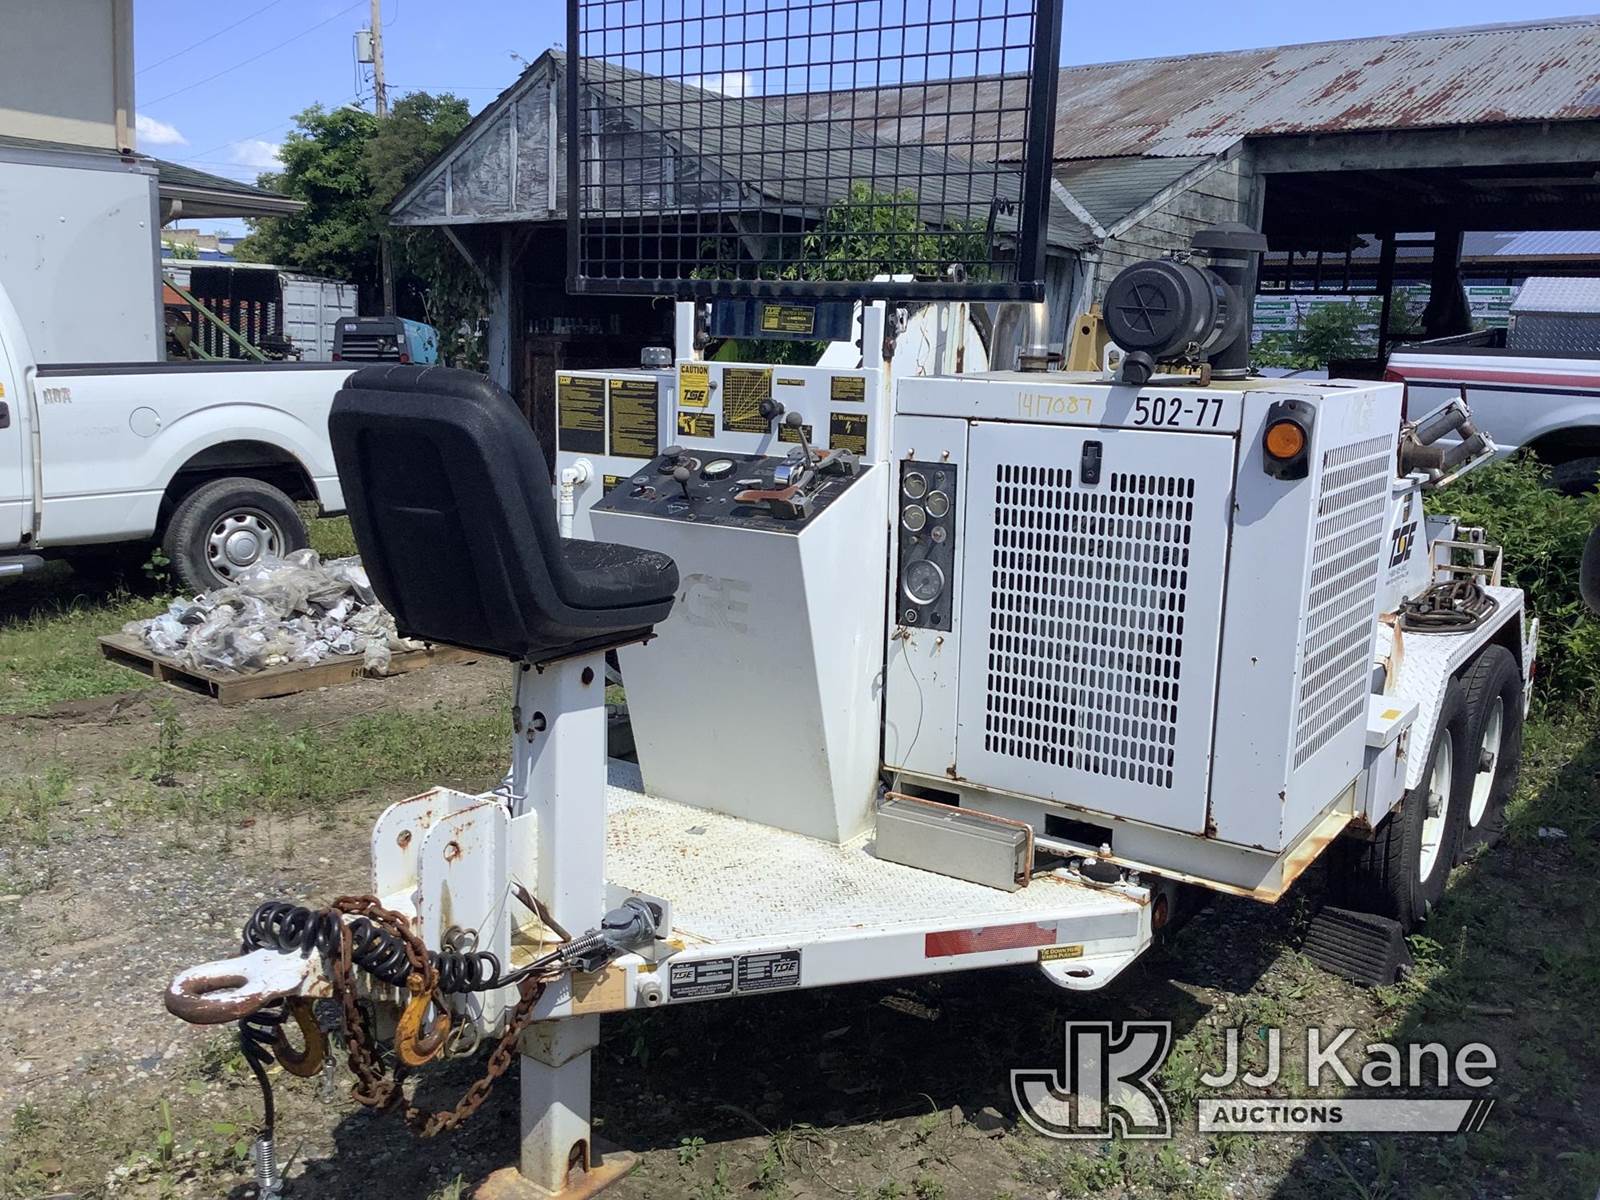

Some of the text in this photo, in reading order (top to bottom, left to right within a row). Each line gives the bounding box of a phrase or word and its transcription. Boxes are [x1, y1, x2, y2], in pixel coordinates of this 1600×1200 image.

[681, 365, 708, 374] CAUTION
[1017, 391, 1092, 417] 1417087
[1134, 397, 1224, 427] 502-77
